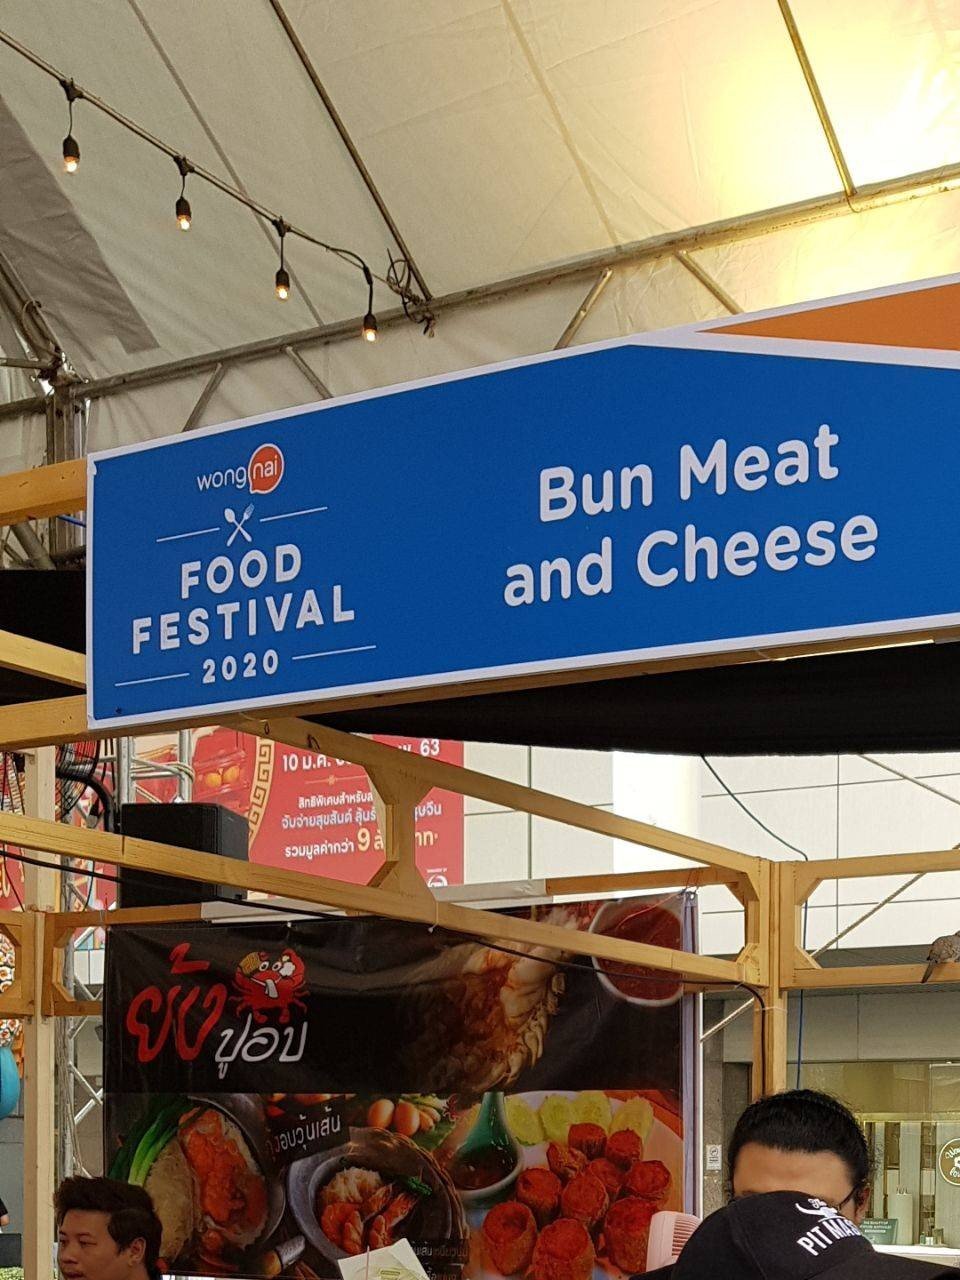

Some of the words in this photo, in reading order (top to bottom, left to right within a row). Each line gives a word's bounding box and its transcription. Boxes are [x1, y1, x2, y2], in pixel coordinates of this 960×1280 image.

[539, 463, 653, 523] Bun
[679, 424, 839, 501] Meat
[180, 543, 302, 600] FOOD
[503, 537, 613, 607] and
[636, 514, 879, 588] Cheese
[131, 584, 355, 655] FESTIVAL
[202, 648, 279, 684] 2020
[283, 753, 299, 773] 10
[420, 738, 440, 758] 63
[357, 827, 371, 852] 9
[797, 1225, 833, 1257] PIT
